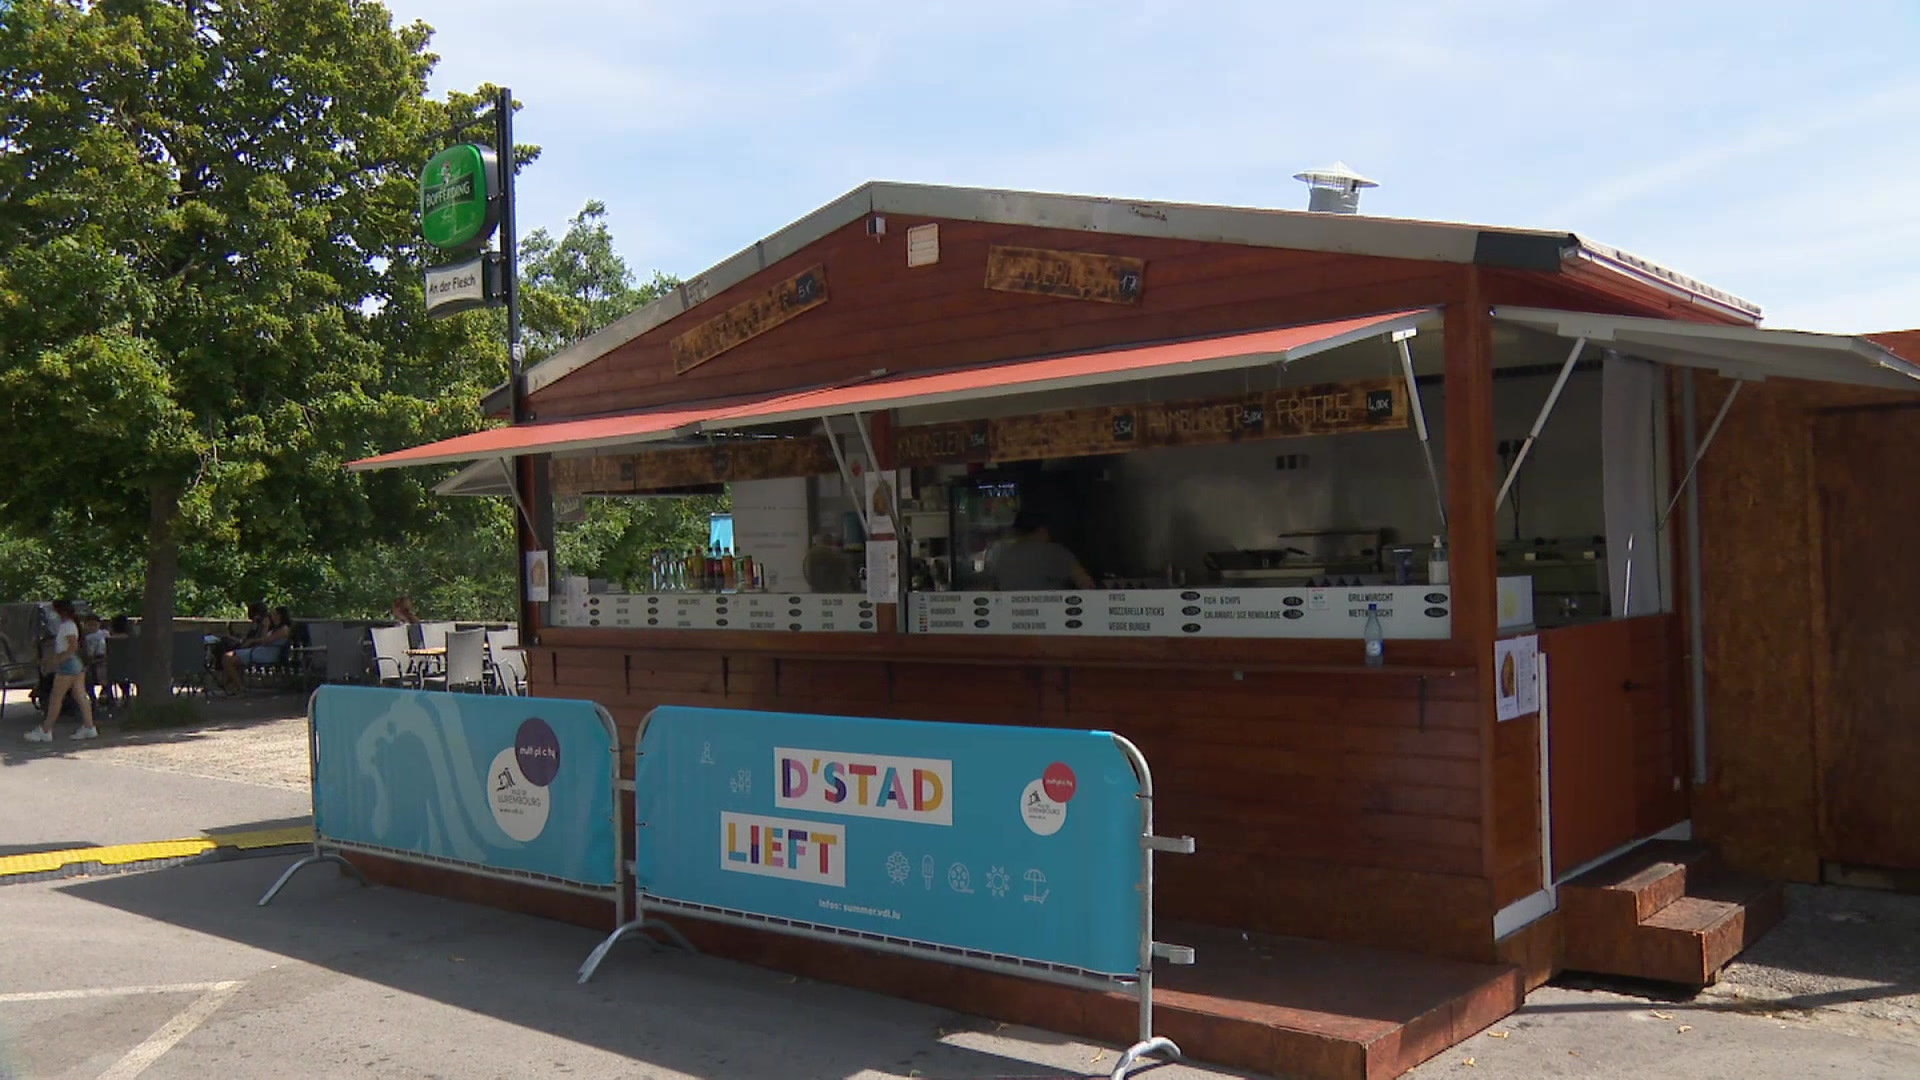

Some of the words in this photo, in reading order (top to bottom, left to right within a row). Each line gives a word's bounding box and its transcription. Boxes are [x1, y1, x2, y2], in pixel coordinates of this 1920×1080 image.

[429, 283, 439, 294] An
[440, 280, 451, 293] der
[1348, 609, 1393, 618] METTWSCHT
[781, 757, 945, 812] D'STAD
[727, 822, 838, 875] LIEFT
[818, 899, 843, 911] Infos:
